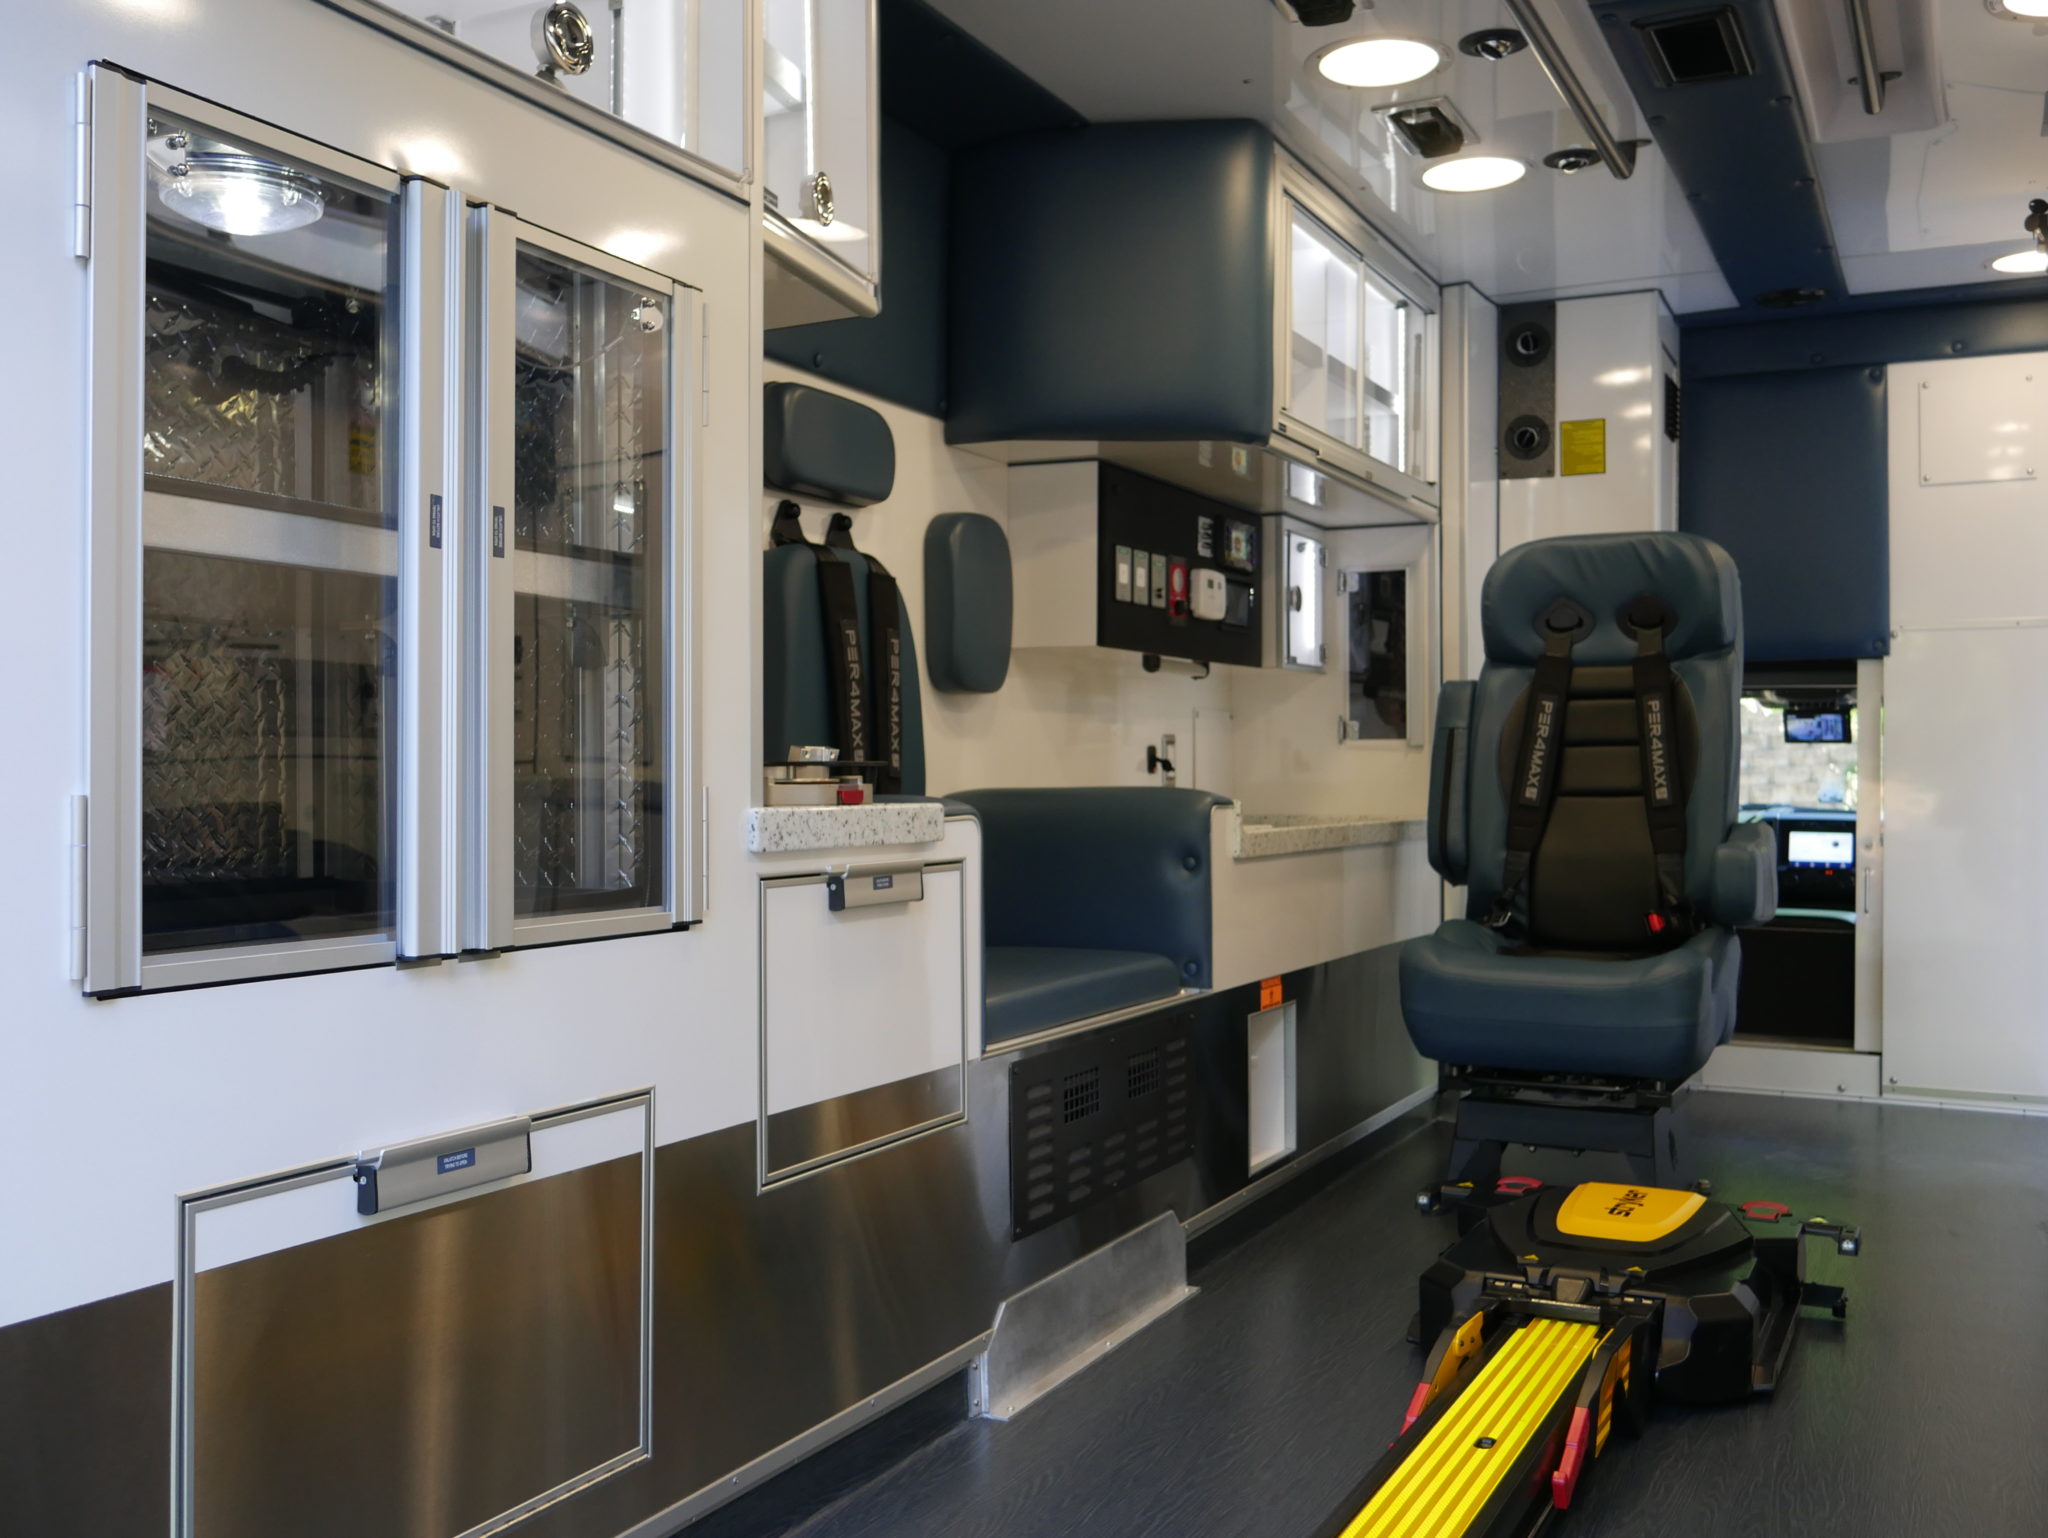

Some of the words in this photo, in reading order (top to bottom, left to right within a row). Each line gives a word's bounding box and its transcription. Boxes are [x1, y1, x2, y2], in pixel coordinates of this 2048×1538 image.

[844, 629, 863, 747] PER4MAX
[890, 638, 900, 750] PER4MAX
[1527, 700, 1553, 787] PER4MAX
[1648, 700, 1667, 787] PER4MAX
